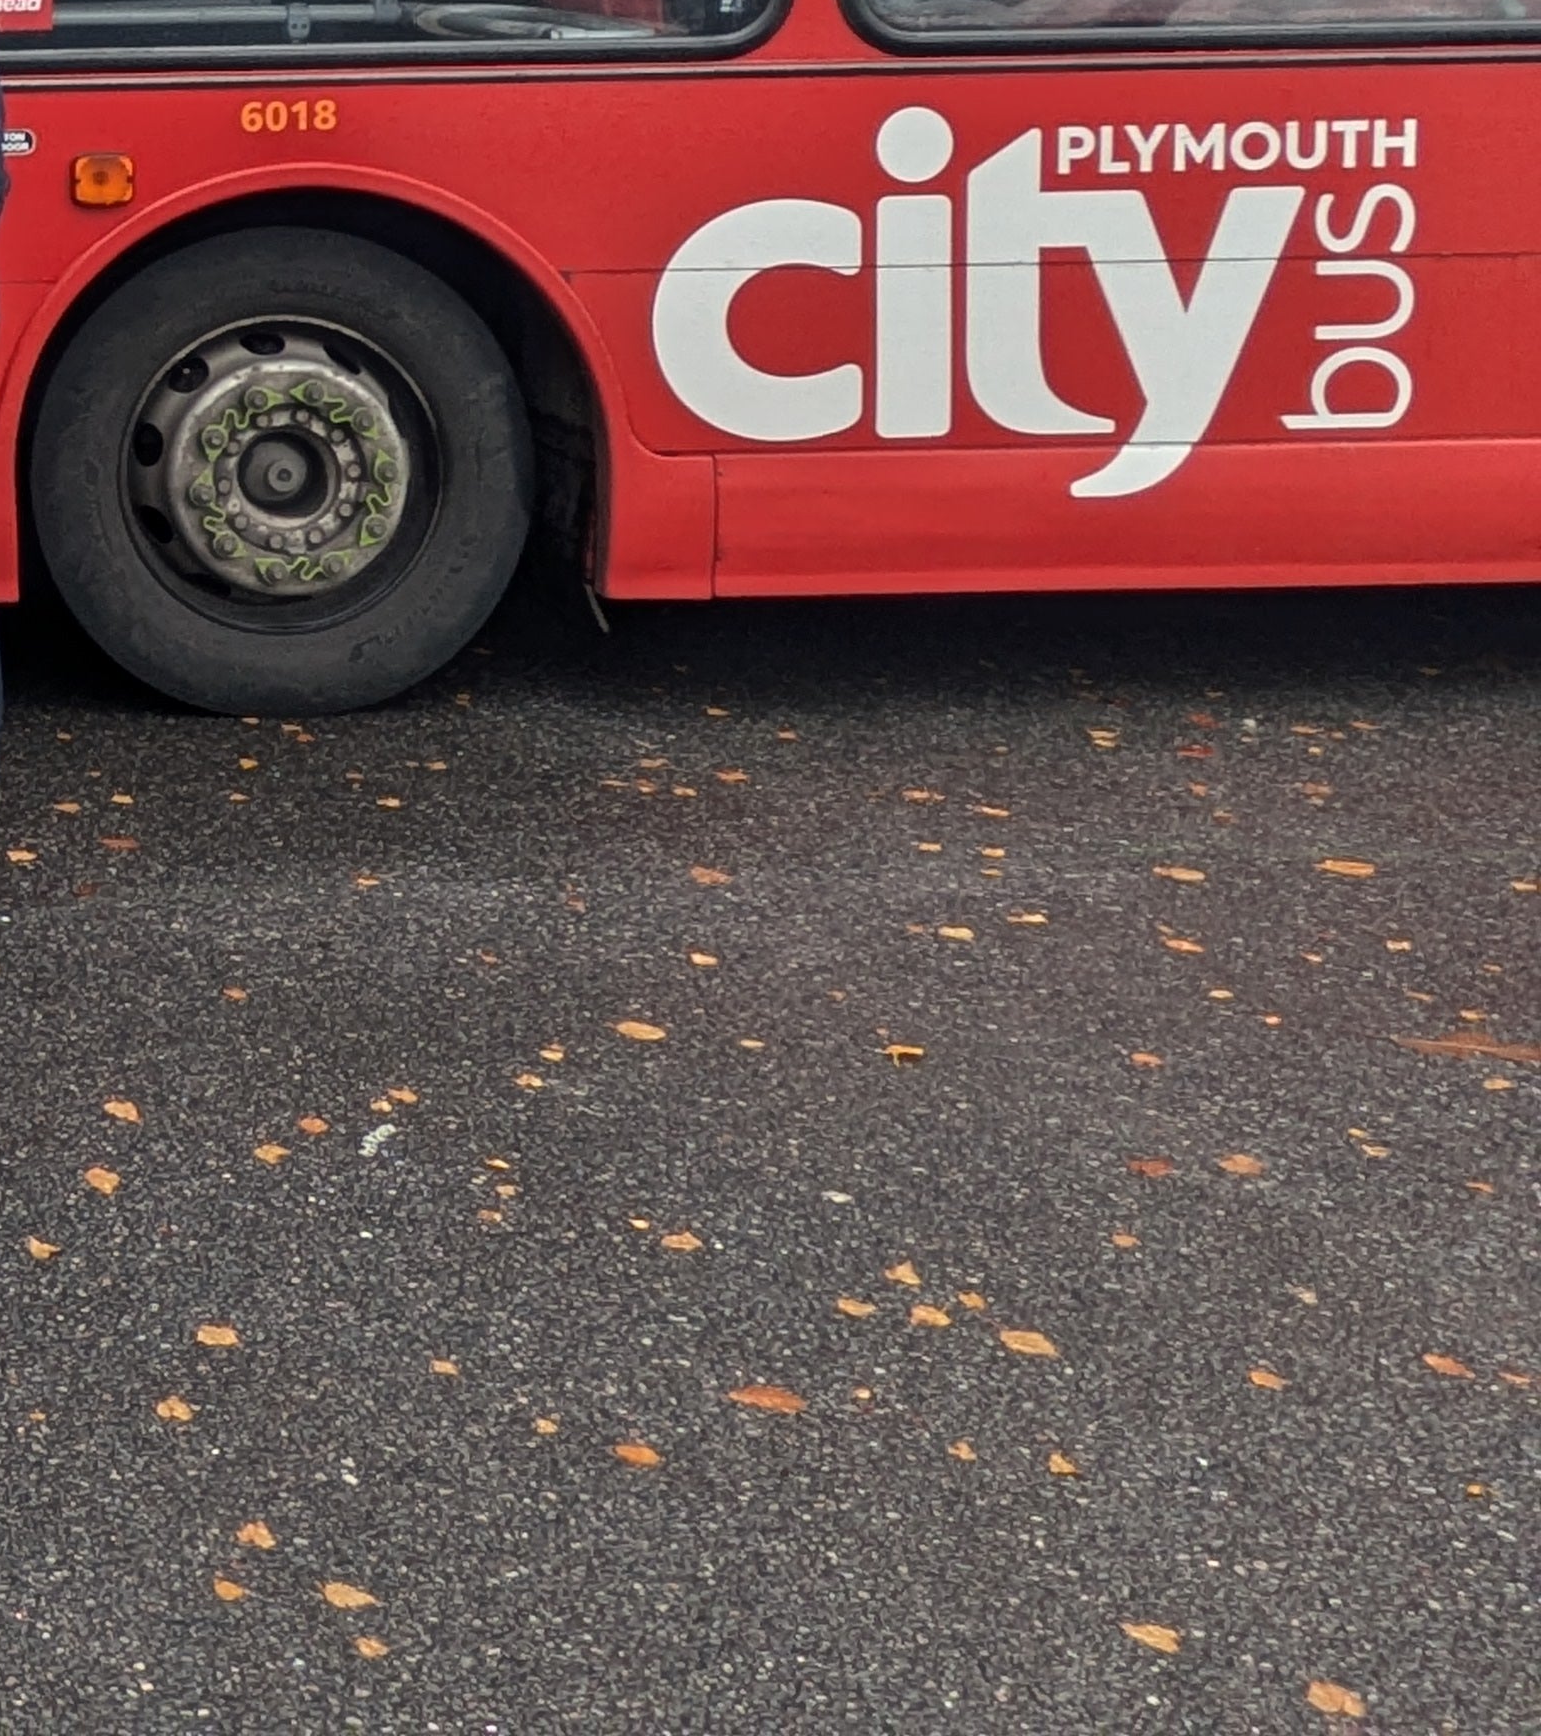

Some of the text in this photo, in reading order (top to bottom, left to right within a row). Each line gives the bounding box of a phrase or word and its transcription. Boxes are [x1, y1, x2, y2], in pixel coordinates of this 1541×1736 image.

[240, 99, 338, 132] 6018
[1057, 117, 1418, 175] PLYMOUTH
[652, 106, 1305, 499] city
[1280, 183, 1417, 430] bus
